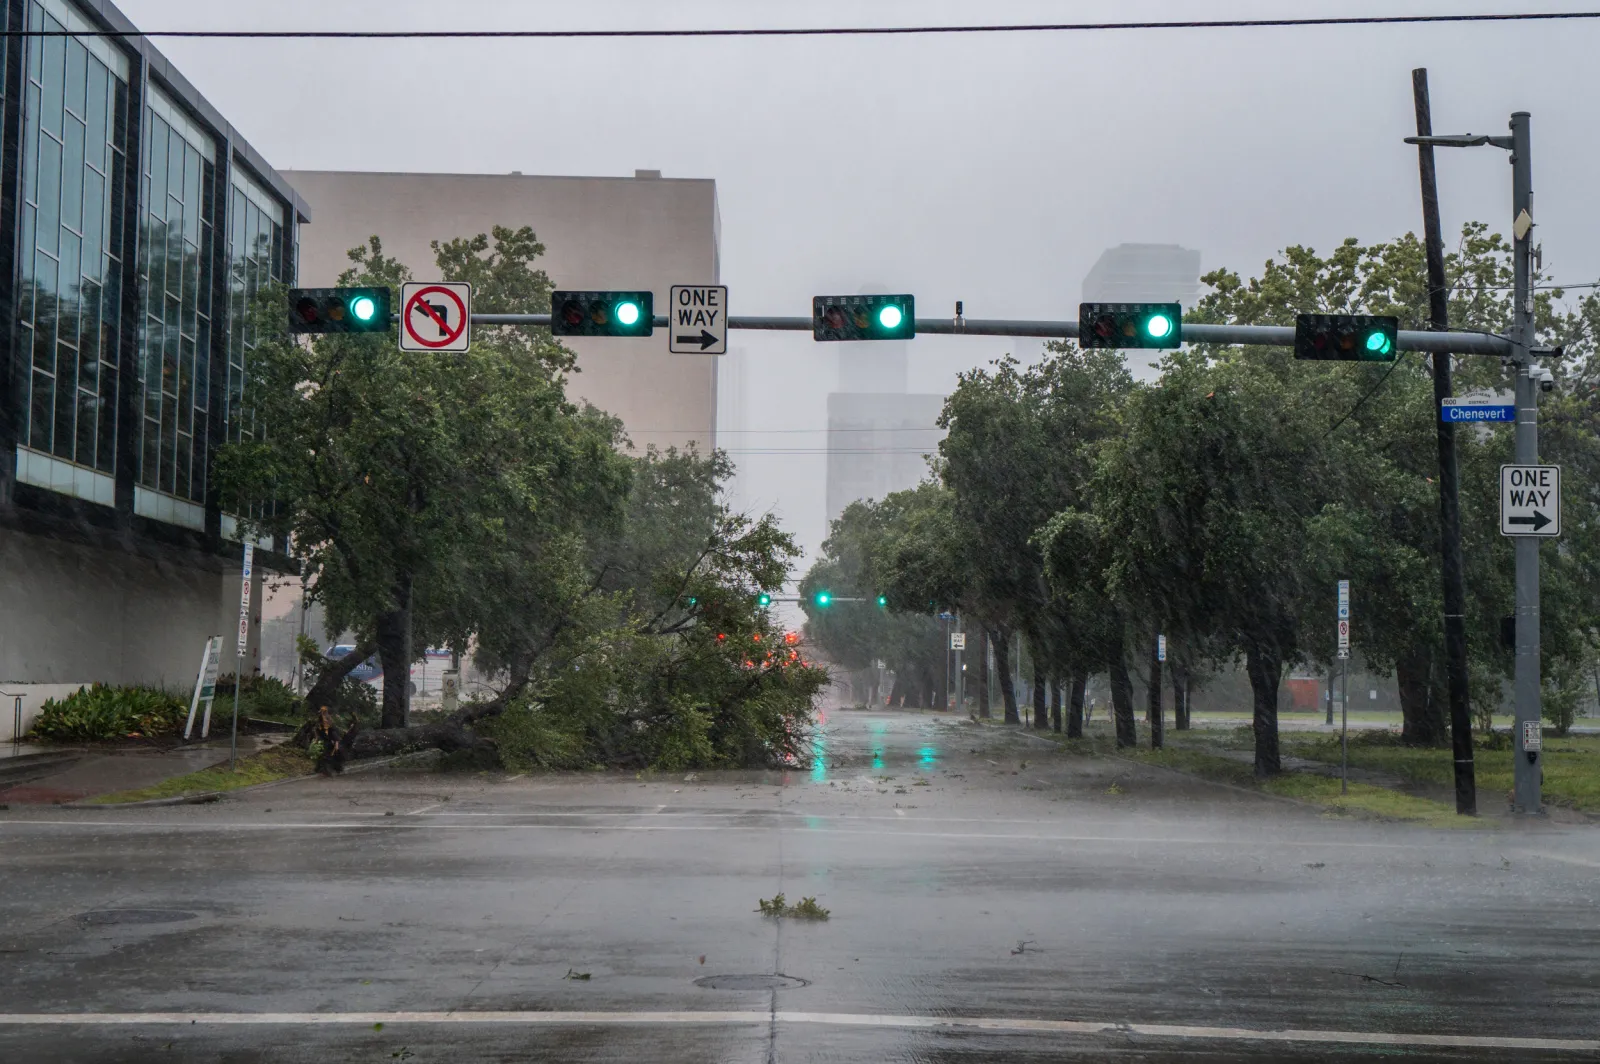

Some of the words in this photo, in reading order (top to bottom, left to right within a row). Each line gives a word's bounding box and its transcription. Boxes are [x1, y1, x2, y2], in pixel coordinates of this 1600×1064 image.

[679, 289, 718, 306] ONE
[678, 309, 718, 326] WAY
[1450, 408, 1506, 419] Chenevert
[1511, 469, 1550, 487] ONE
[1510, 490, 1551, 507] WAY
